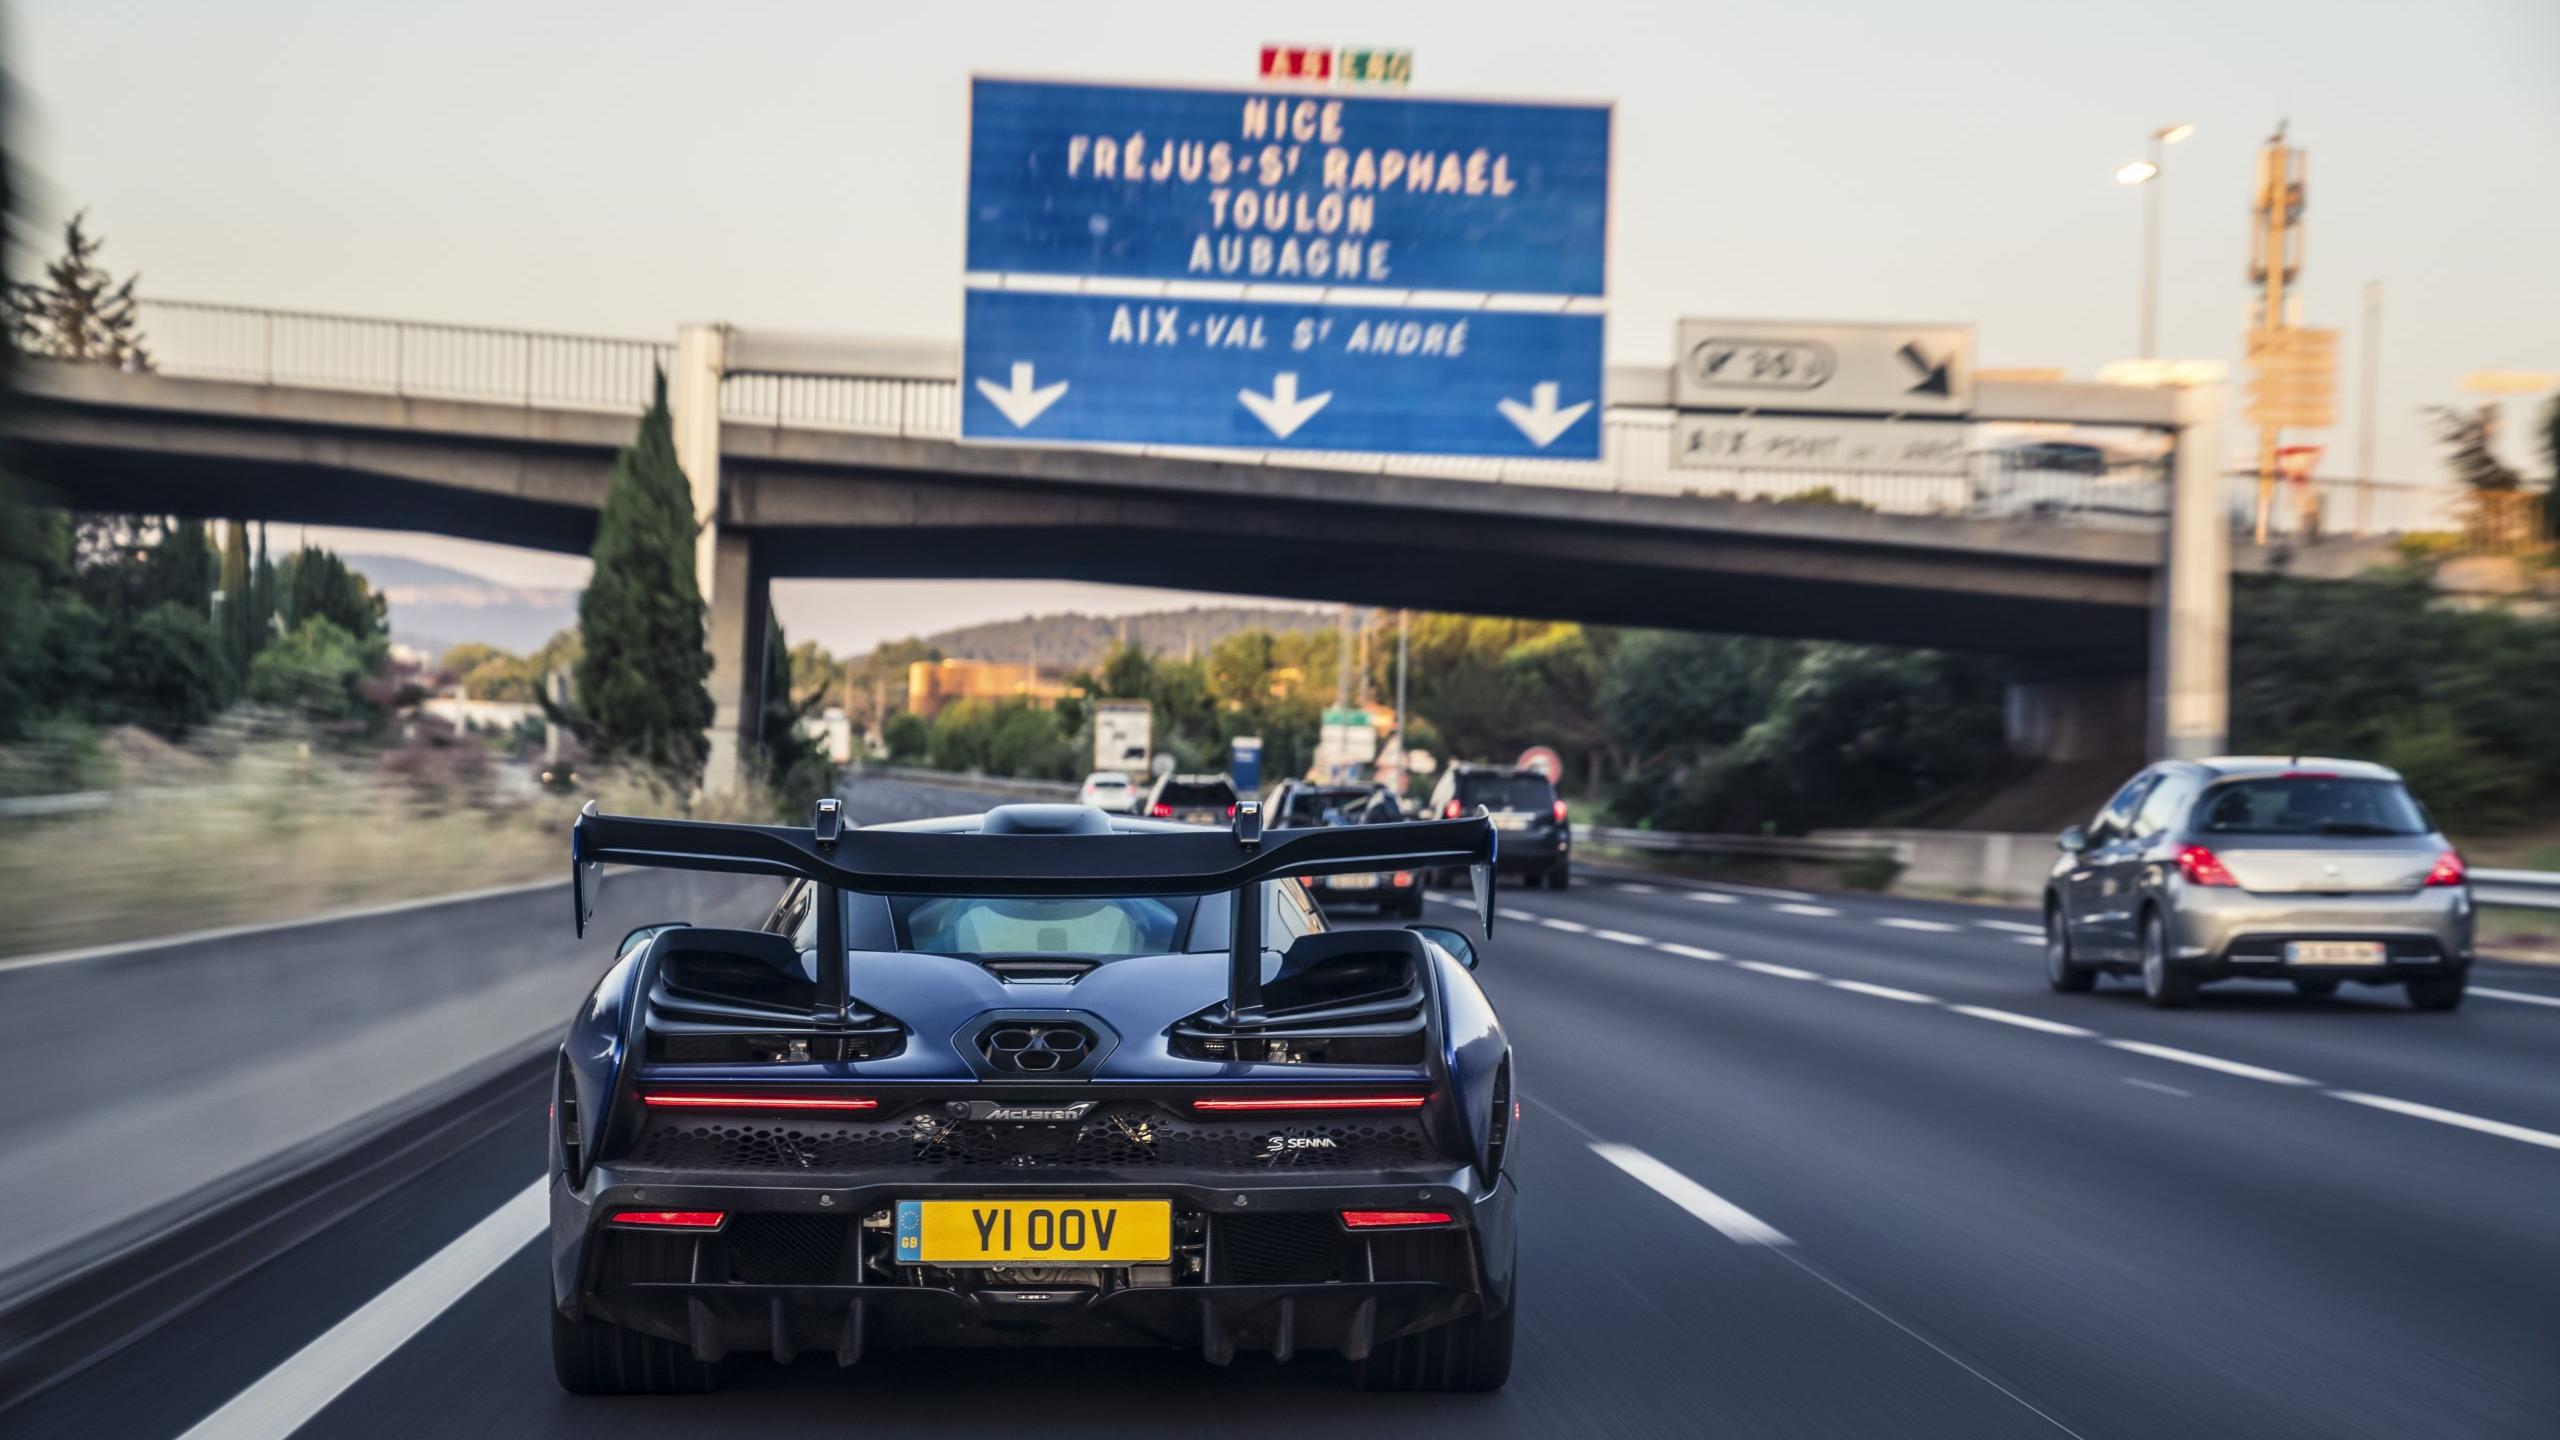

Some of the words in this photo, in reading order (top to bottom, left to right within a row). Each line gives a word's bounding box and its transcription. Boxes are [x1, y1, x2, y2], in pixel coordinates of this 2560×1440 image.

[1242, 98, 1343, 143] NICE
[1209, 189, 1375, 236] TOULON
[1188, 232, 1391, 280] AUBAGNE
[1345, 316, 1469, 358] ANDRÉ
[985, 1109, 1079, 1120] McLaren
[1287, 1138, 1337, 1148] SENNA
[901, 1236, 918, 1249] GB
